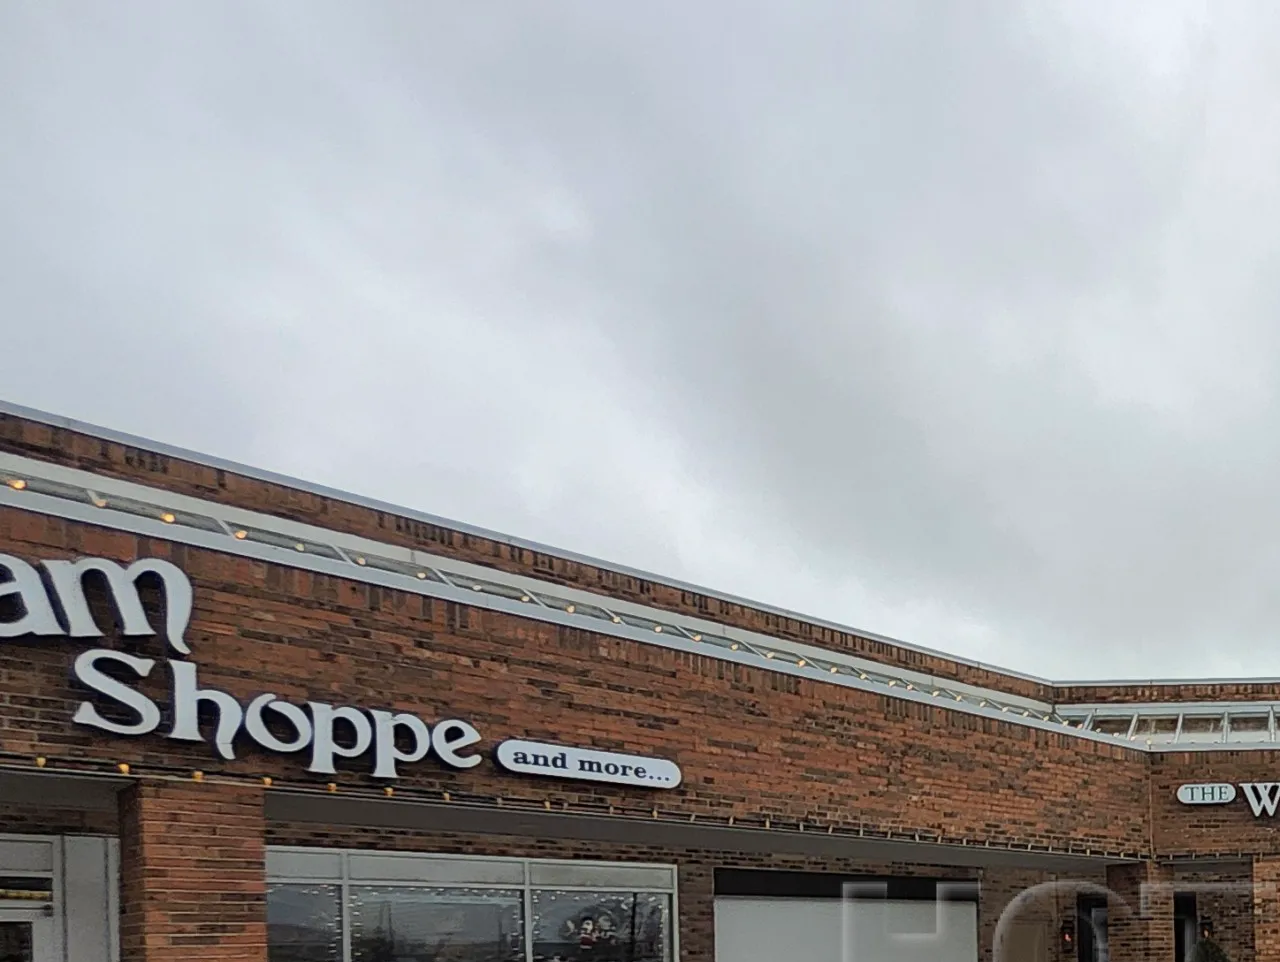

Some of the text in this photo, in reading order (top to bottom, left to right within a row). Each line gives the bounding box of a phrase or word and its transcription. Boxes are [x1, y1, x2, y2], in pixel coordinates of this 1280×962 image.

[73, 649, 482, 778] Shoppe
[512, 750, 670, 782] and more...
[1184, 785, 1229, 801] THE
